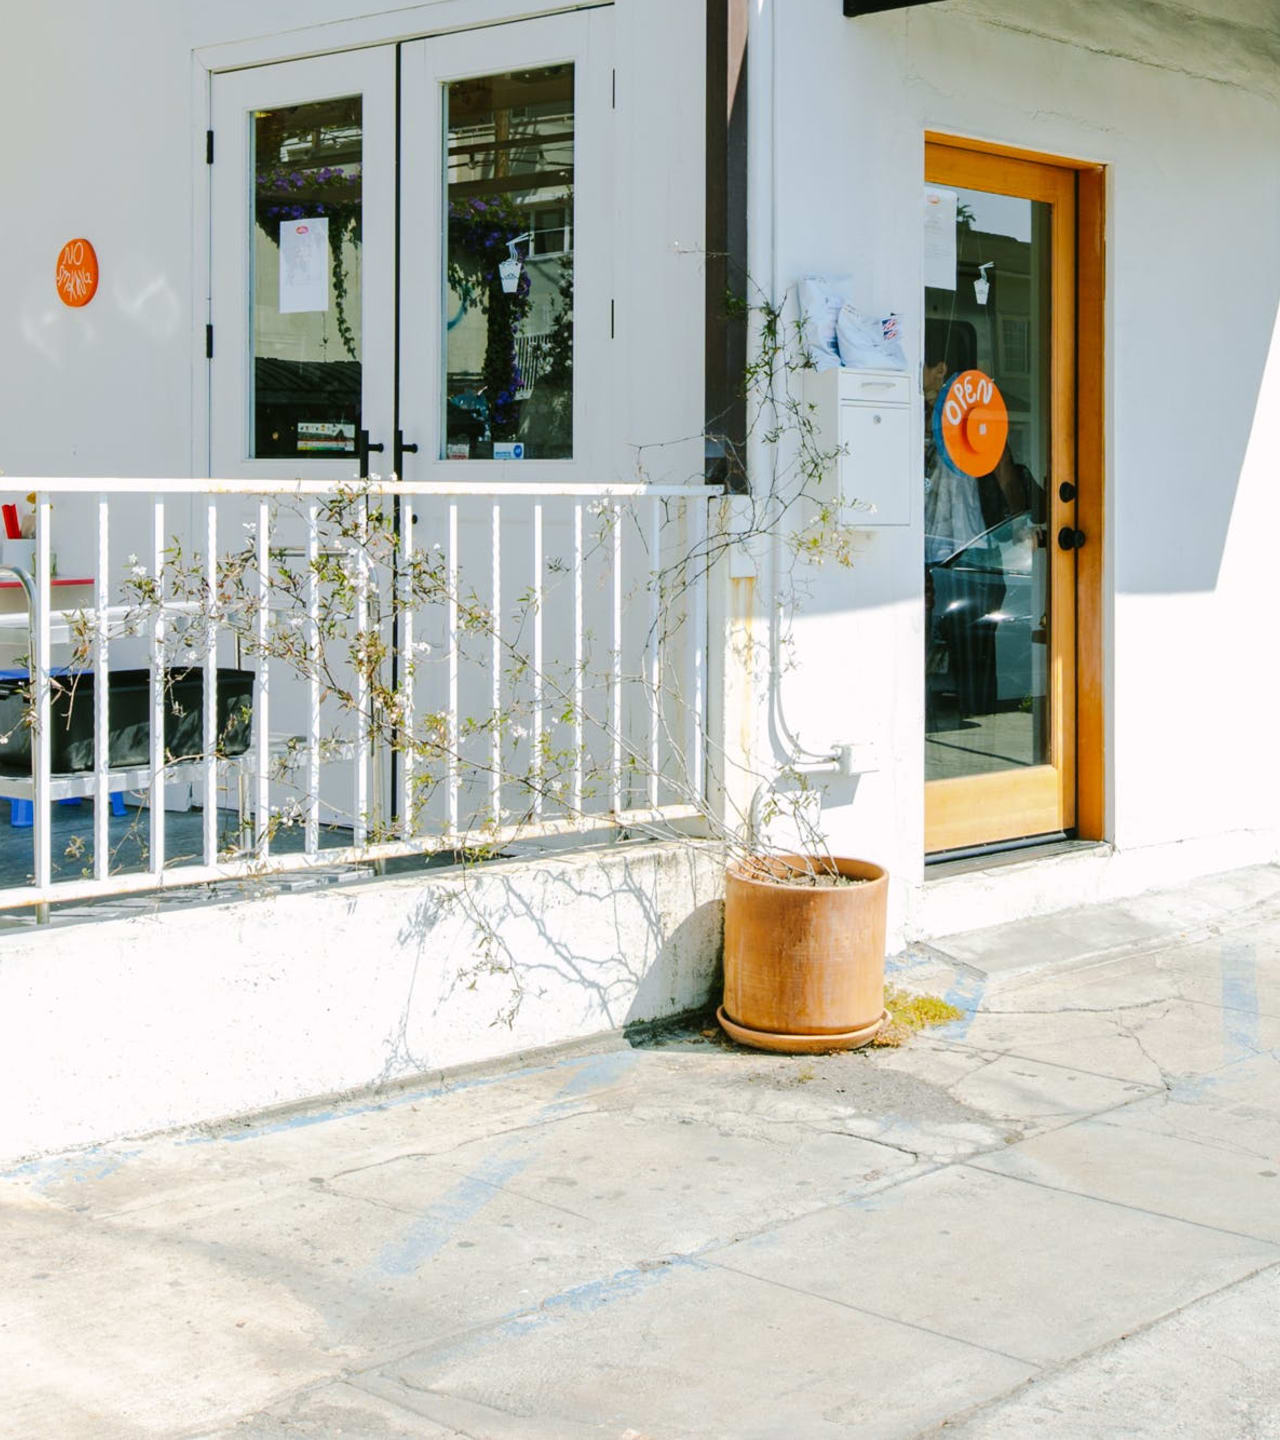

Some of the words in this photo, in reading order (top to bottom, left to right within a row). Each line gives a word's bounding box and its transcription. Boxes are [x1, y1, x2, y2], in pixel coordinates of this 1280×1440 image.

[63, 242, 84, 266] NO
[56, 265, 93, 303] SMOKING
[945, 375, 994, 427] OPEN
